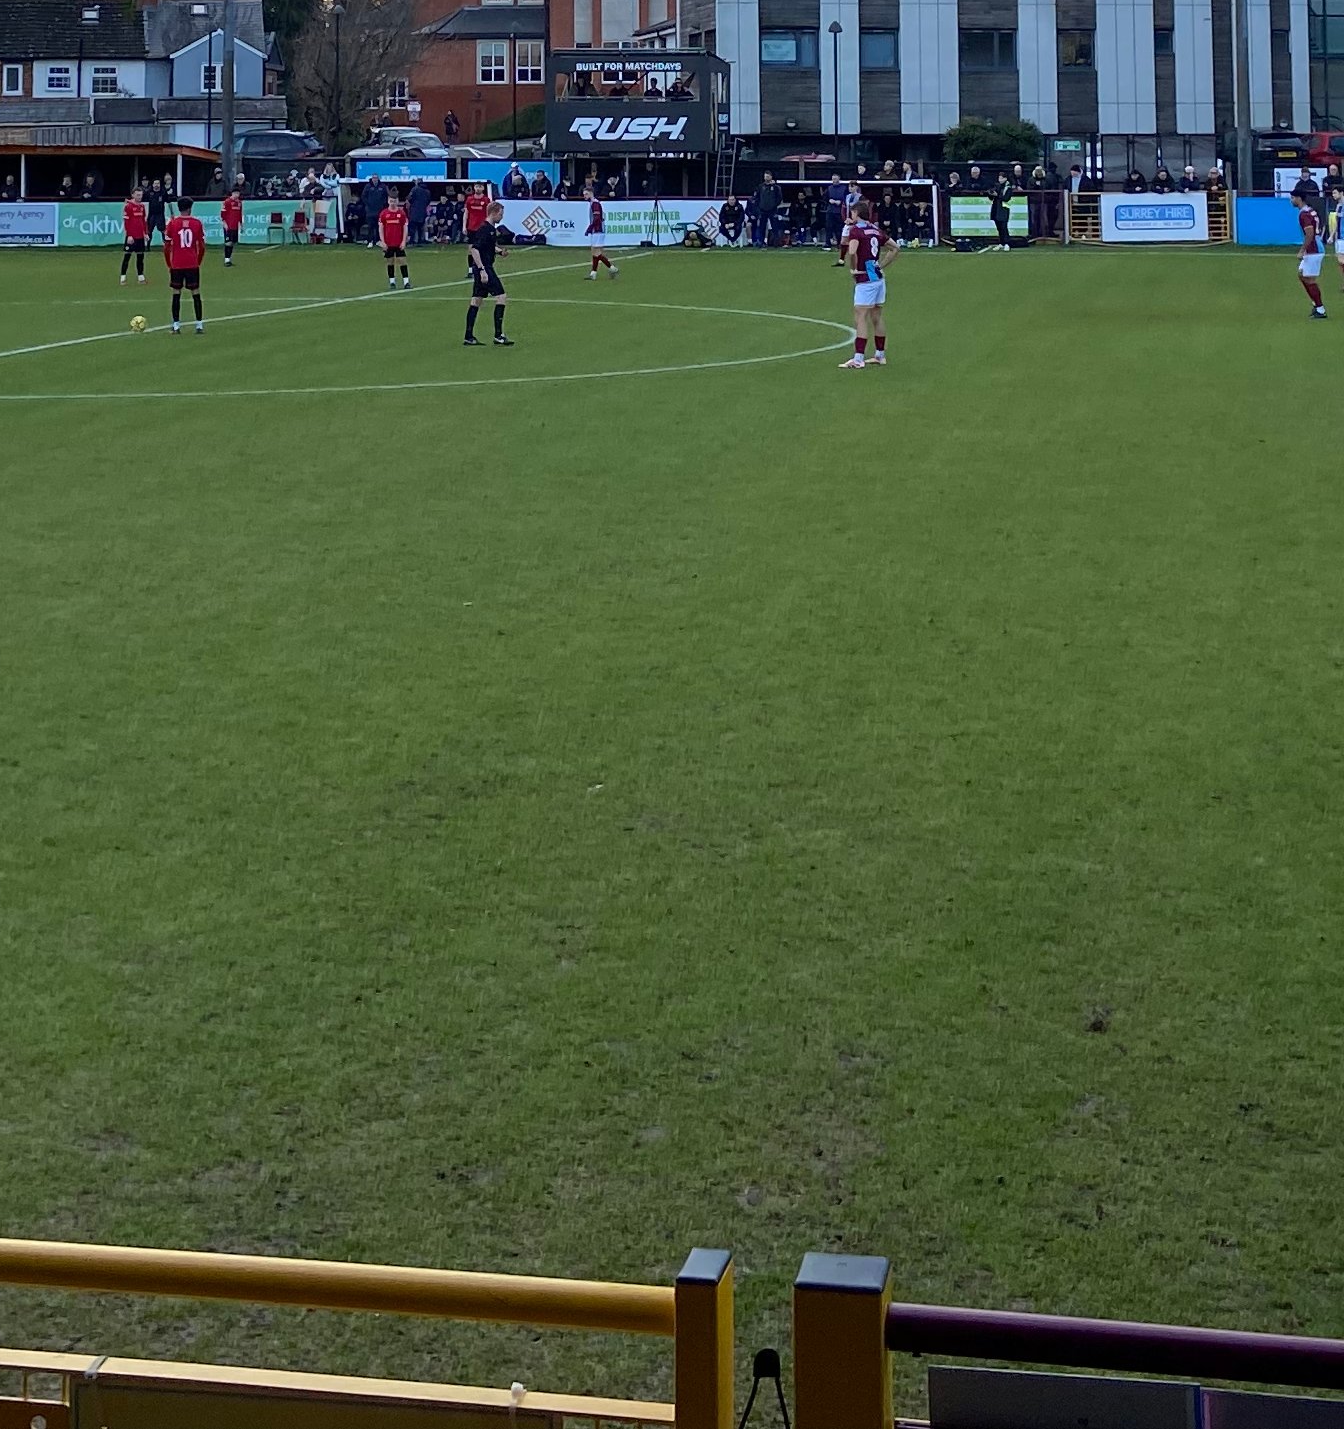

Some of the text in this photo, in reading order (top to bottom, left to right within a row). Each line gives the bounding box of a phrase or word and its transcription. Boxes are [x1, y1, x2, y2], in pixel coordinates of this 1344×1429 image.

[576, 62, 682, 71] BUILT FOR MATCHDAYS
[1119, 206, 1190, 220] SURREY HIRE
[177, 228, 193, 248] 10
[870, 236, 879, 257] 8
